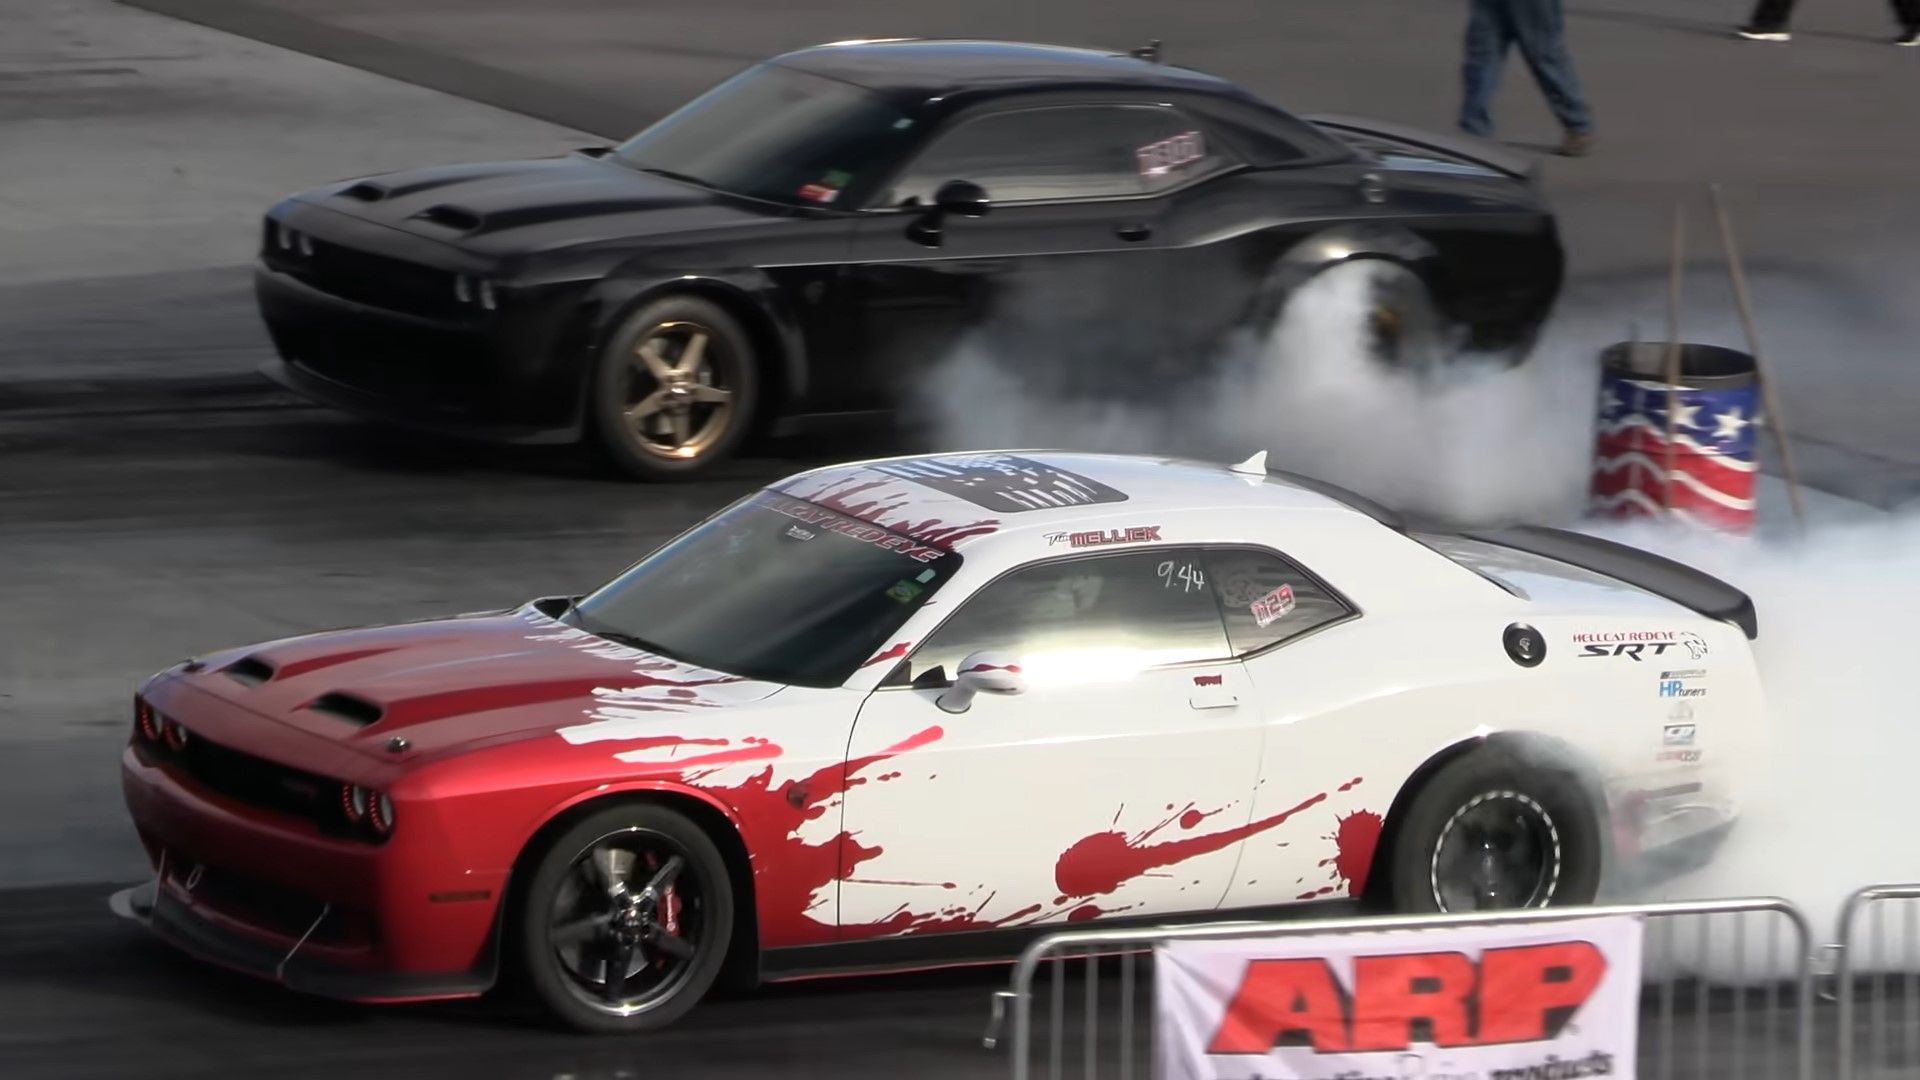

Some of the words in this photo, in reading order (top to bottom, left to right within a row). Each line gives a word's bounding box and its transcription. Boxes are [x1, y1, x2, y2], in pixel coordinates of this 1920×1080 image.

[1157, 560, 1205, 593] 9.44
[1573, 633, 1627, 643] HELLCAT
[1629, 631, 1677, 641] REDEYE
[1578, 642, 1677, 661] SRT
[1206, 940, 1608, 1054] ARP
